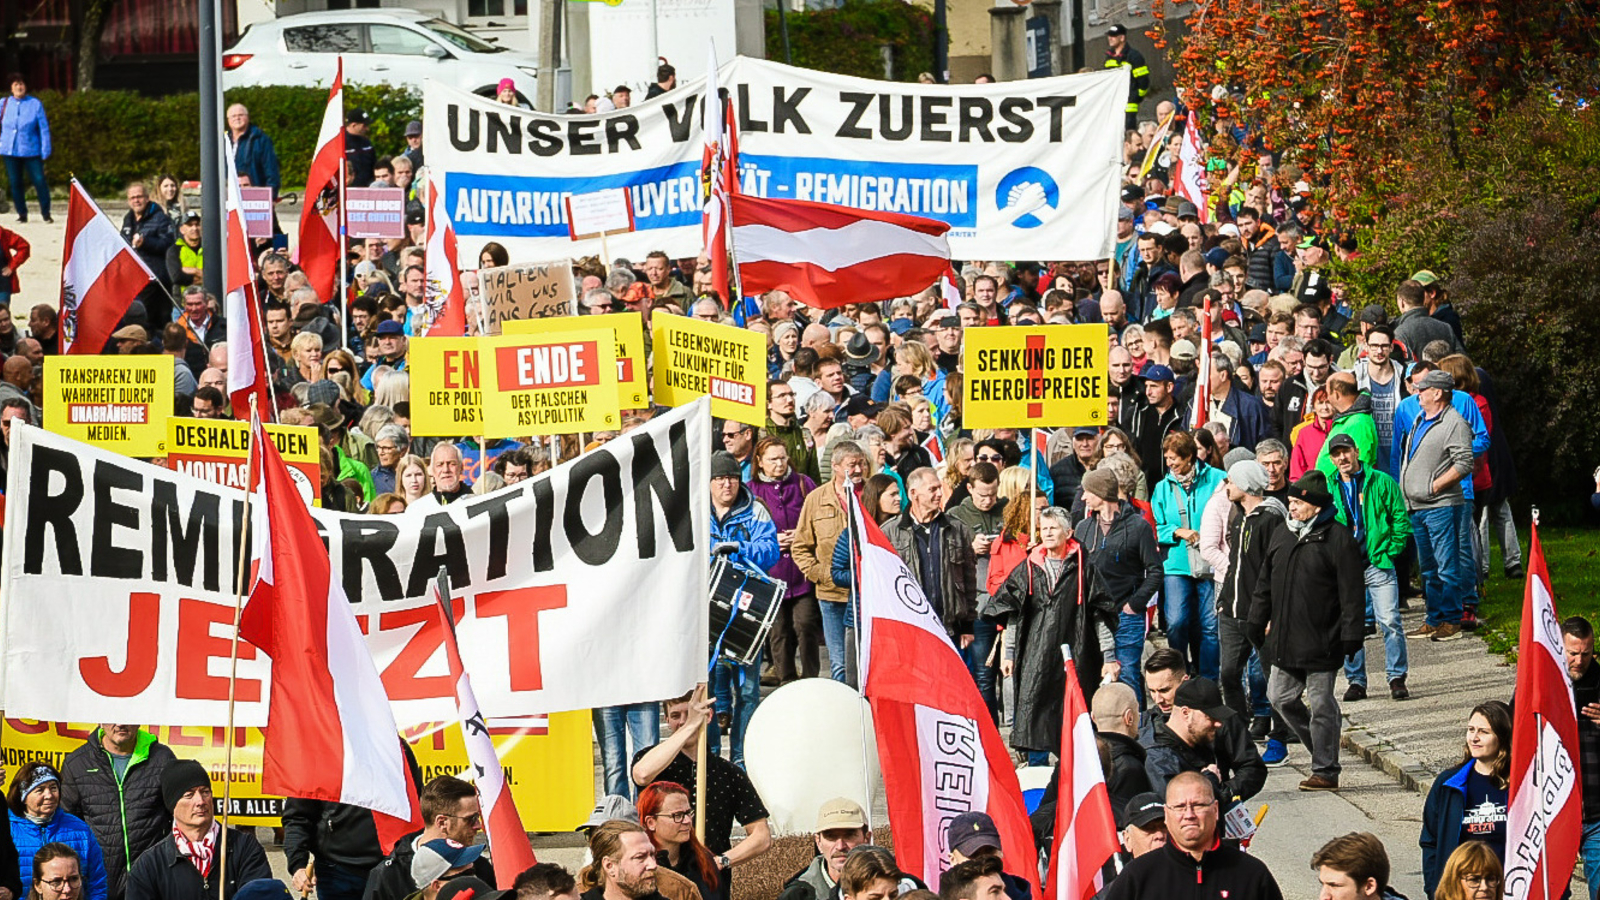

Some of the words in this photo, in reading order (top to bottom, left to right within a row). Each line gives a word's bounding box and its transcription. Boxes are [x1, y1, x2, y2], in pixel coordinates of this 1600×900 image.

[448, 103, 641, 156] UNSER
[835, 91, 1077, 143] ZUERST
[795, 172, 968, 214] REMIGRATION
[486, 290, 516, 306] WIR
[532, 283, 558, 298] UNS
[670, 329, 749, 362] LEBENSWERTE
[517, 344, 586, 386] ENDE
[673, 351, 721, 376] ZUKUNFT
[725, 360, 745, 381] FÜR
[978, 348, 1055, 371] SENKUNG
[1062, 347, 1093, 369] DER
[60, 368, 132, 384] TRANSPARENZ
[135, 368, 156, 384] UND
[666, 369, 707, 394] UNSERE
[711, 378, 753, 404] KINDER
[61, 387, 116, 403] WAHRHEIT
[119, 387, 154, 403] DURCH
[429, 391, 449, 406] DER
[512, 393, 532, 410] DER
[535, 390, 588, 408] FALSCHEN
[971, 376, 1101, 401] ENERGIEPREISE
[71, 404, 145, 423] UNABHÄNGIGE
[454, 408, 475, 422] DAS
[518, 407, 585, 426] ASYLPOLITIK
[605, 415, 612, 424] G
[87, 426, 131, 441] MEDIEN.
[176, 425, 249, 450] DESHALB
[158, 442, 165, 450] G
[23, 419, 695, 603] REMIRATION
[78, 584, 568, 704] JEZT
[246, 799, 277, 815] ALLE
